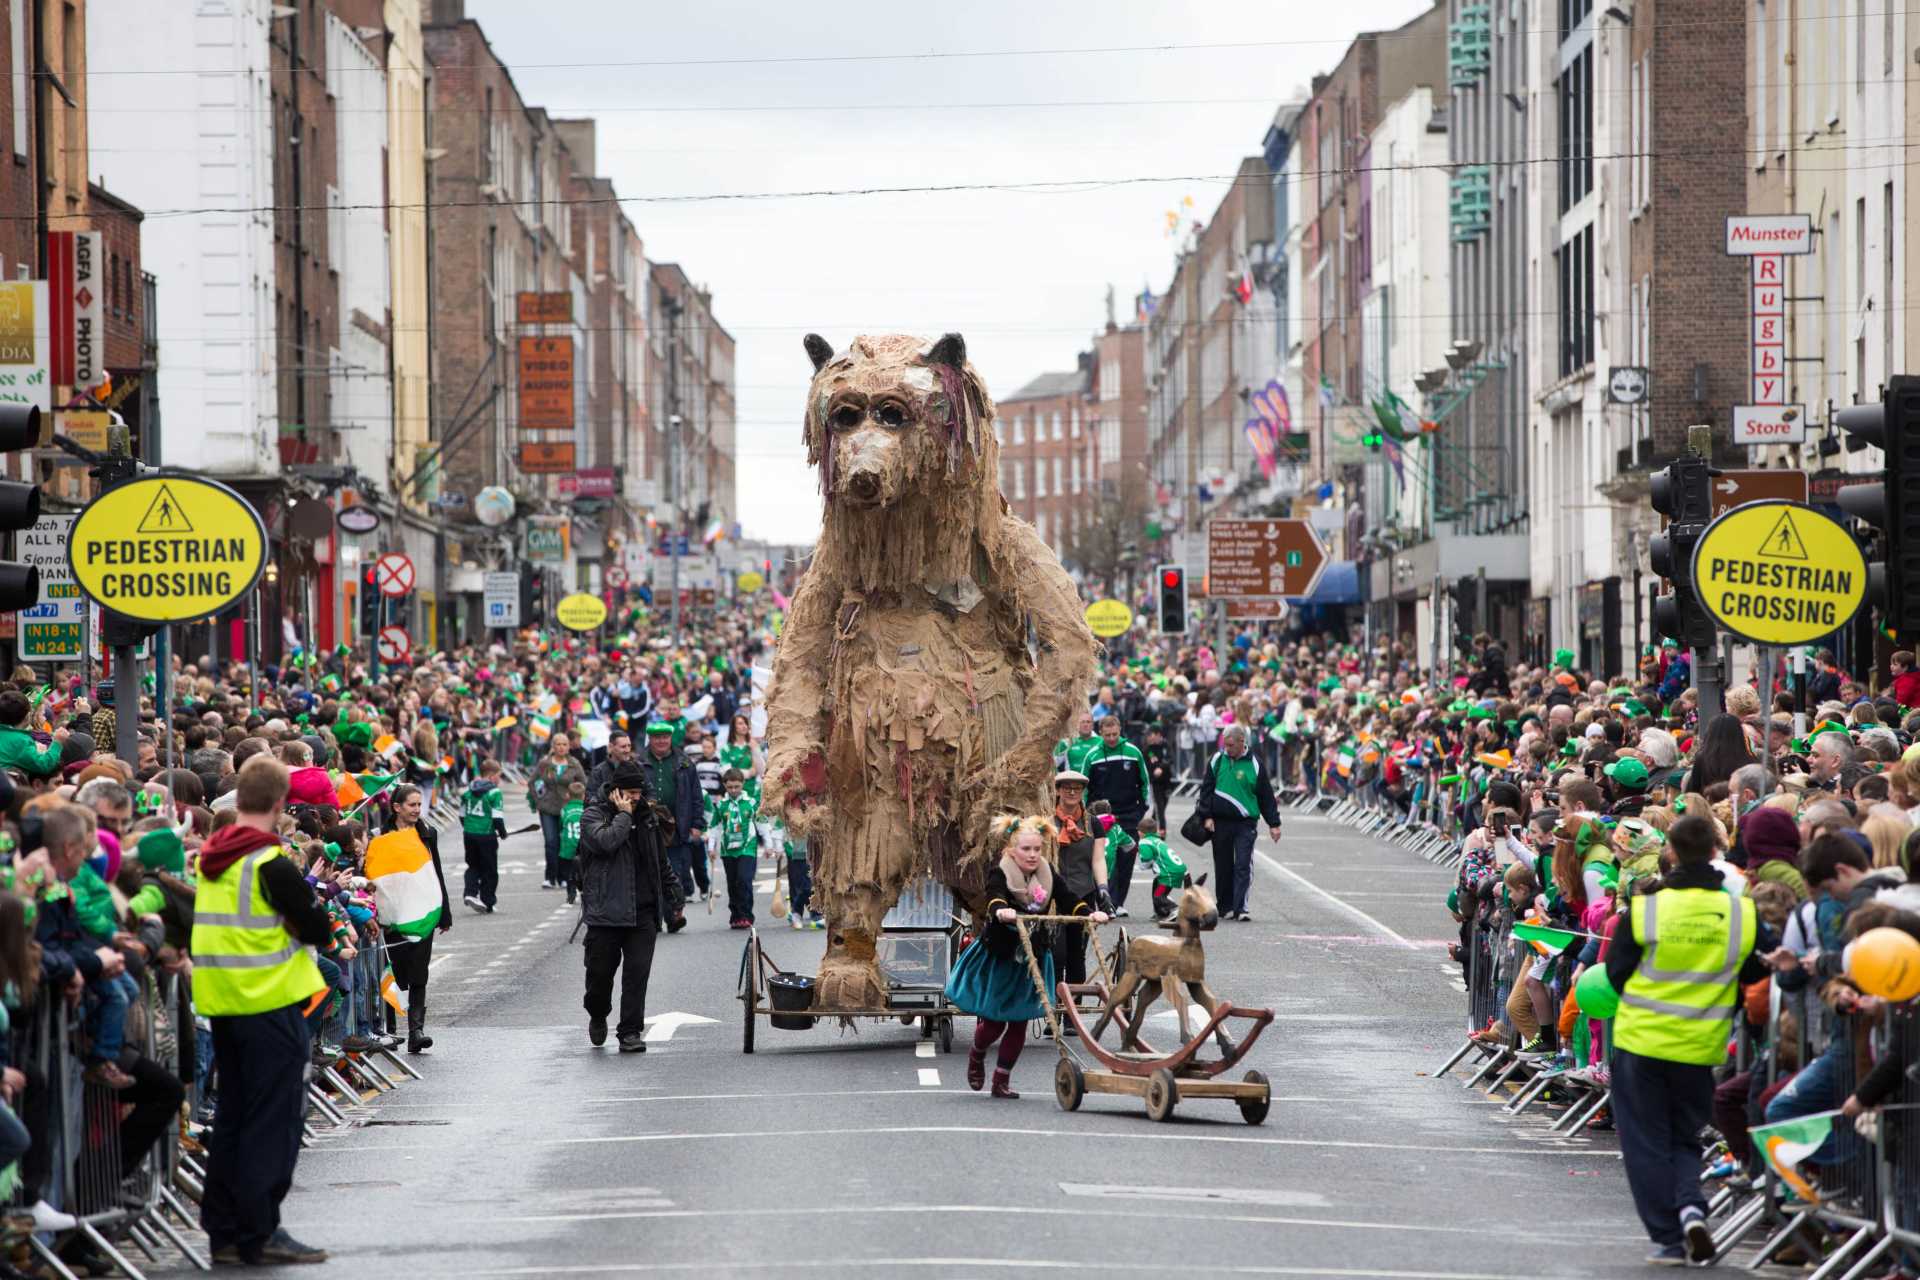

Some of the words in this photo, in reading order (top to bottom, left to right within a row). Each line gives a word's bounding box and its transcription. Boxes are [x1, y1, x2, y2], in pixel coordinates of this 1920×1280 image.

[1731, 226, 1806, 240] Munster
[77, 235, 91, 281] AGFA
[78, 318, 91, 382] PHOTO
[525, 361, 570, 372] VIDEO
[525, 380, 570, 391] AUDIO
[1746, 420, 1791, 435] Store
[87, 539, 245, 565] PEDESTRIAN
[101, 571, 232, 599] CROSSING
[1711, 558, 1852, 594] PEDESTRIAN
[1721, 591, 1837, 625] CROSSING
[464, 800, 485, 816] 14
[1167, 847, 1183, 866] 6
